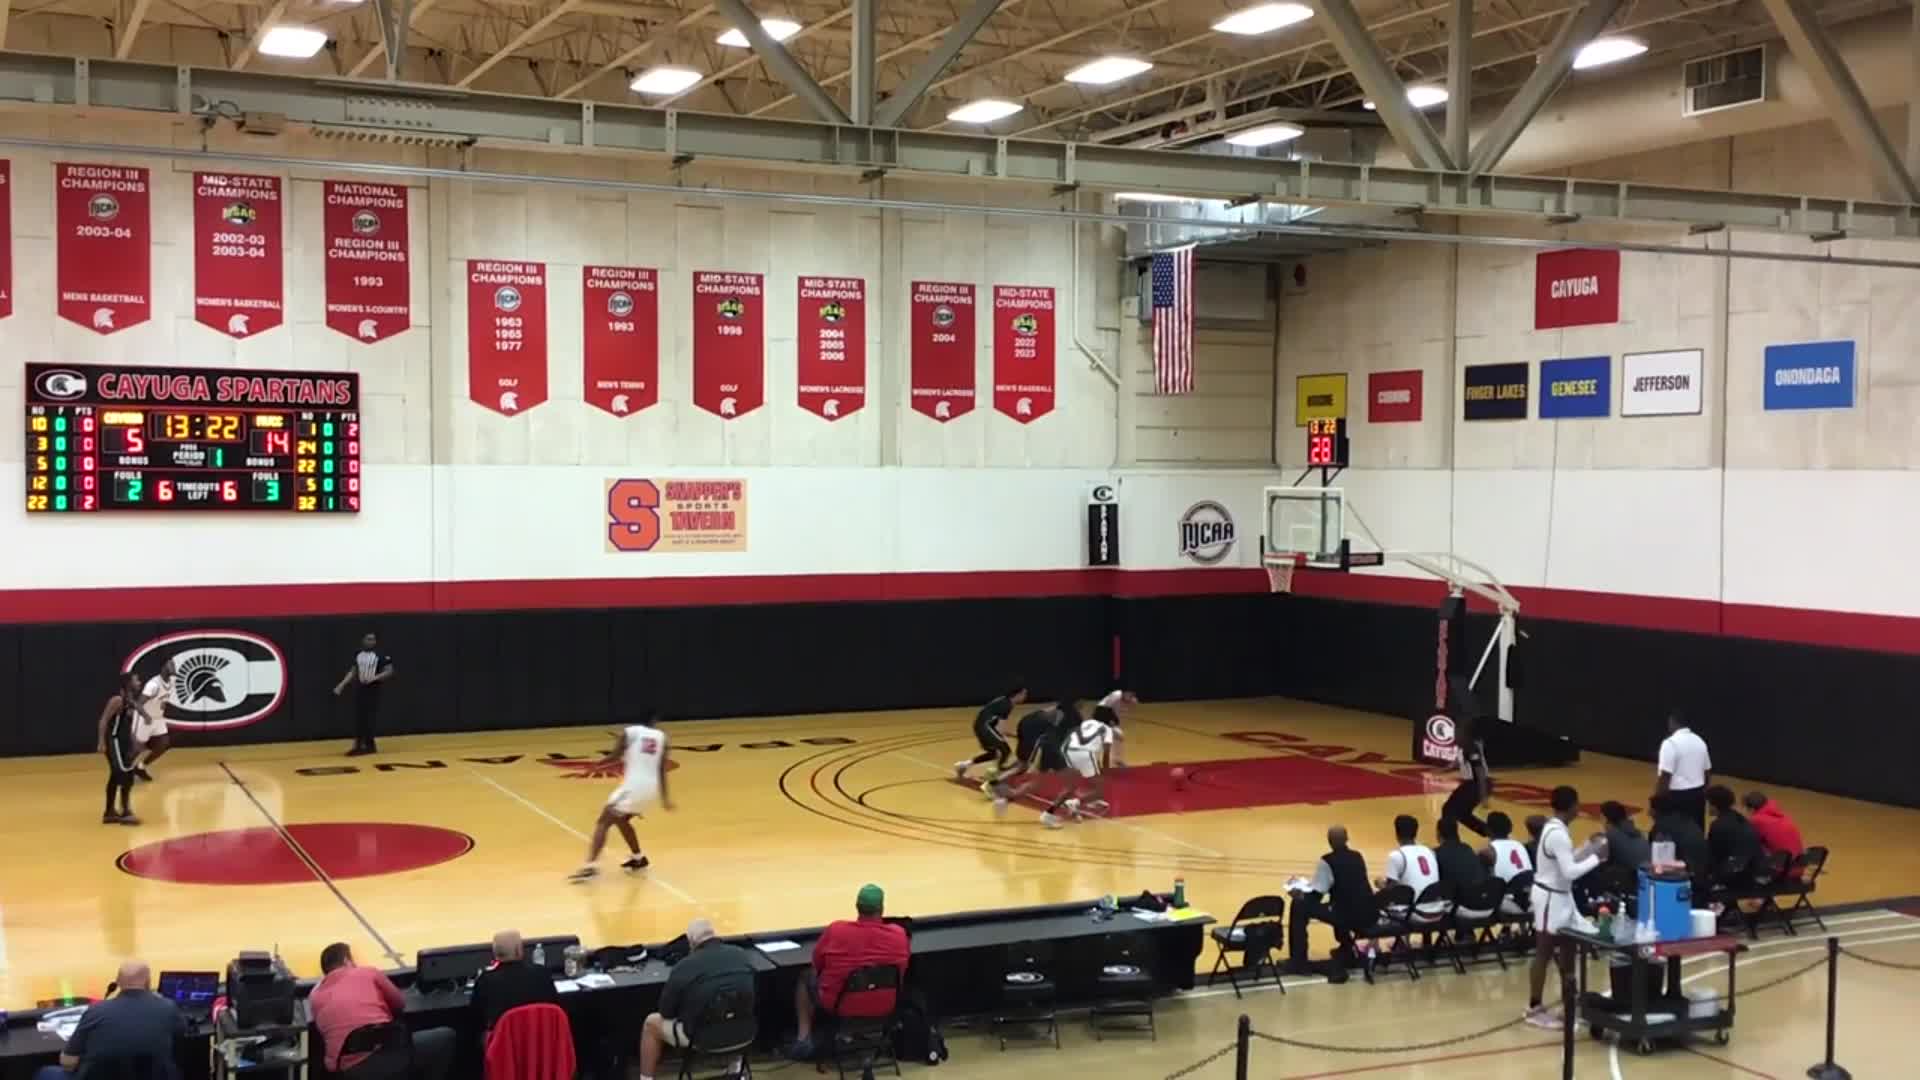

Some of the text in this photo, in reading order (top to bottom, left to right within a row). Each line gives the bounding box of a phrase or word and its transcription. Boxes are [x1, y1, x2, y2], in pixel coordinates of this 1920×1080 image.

[67, 167, 139, 180] REGION III
[61, 178, 145, 192] CHAMPIONS
[202, 175, 272, 189] MID-STATE
[198, 186, 277, 201] CHAMPIONS
[334, 184, 398, 197] NATIONAL
[328, 194, 404, 209] CHAMPIONS
[76, 225, 131, 239] 2003-04
[213, 232, 265, 245] 2002-03
[335, 237, 400, 250] REGION III
[212, 245, 265, 258] 2003-04
[329, 248, 405, 262] CHAMPIONS
[476, 262, 537, 275] REGION III
[591, 268, 649, 280] REGION III
[353, 276, 384, 287] 1993
[471, 273, 543, 286] CHAMPIONS
[587, 278, 655, 291] CHAMPIONS
[700, 274, 757, 285] MID-STATE
[804, 280, 859, 290] MID-STATE
[696, 284, 760, 296] CHAMPIONS
[919, 284, 969, 295] REGION III
[1000, 288, 1050, 299] MID-STATE
[1551, 275, 1599, 299] CAYUGA
[90, 293, 144, 304] BASKETBALL
[800, 289, 862, 300] CHAMPIONS
[914, 293, 973, 305] CHAMPIONS
[996, 298, 1053, 310] CHAMPIONS
[495, 341, 522, 351] 1977
[1774, 366, 1841, 387] ONONDAGA
[97, 373, 351, 404] CAYUGA SPARTANS
[1551, 379, 1598, 397] GENESEE
[1632, 375, 1690, 393] JEFFERSON
[1496, 384, 1526, 400] LAKES
[55, 417, 66, 432] 0
[84, 418, 94, 431] 0
[166, 415, 239, 439] 13:22
[323, 422, 334, 437] 0
[349, 423, 358, 437] 2
[38, 437, 94, 451] 3 0 0
[127, 428, 144, 453] 5
[267, 431, 289, 454] 14
[298, 441, 359, 455] 24 0 0
[1311, 437, 1331, 463] 28
[38, 456, 94, 471] 5 0 0
[119, 456, 149, 466] BONUS
[173, 452, 205, 461] PERIOD
[216, 448, 223, 468] 1
[246, 457, 275, 467] BONUS
[298, 459, 359, 474] 22 0 0
[114, 471, 142, 480] FOULS
[253, 472, 279, 481] FOULS
[33, 476, 94, 490] 12 0 0
[176, 482, 220, 492] TIMEOUTS
[306, 478, 359, 492] 5 0 0
[128, 481, 142, 501] 2
[158, 481, 173, 501] 6
[188, 491, 208, 501] LEFT
[223, 481, 237, 501] 6
[266, 481, 280, 501] 3
[28, 495, 94, 510] 22 0 2
[298, 496, 316, 510] 32
[328, 497, 334, 510] 1
[677, 502, 729, 510] SPORTS
[608, 478, 660, 551] S
[669, 511, 736, 530] TAVERN
[1180, 521, 1235, 552] NJCAA
[1416, 855, 1431, 877] 0
[1509, 849, 1524, 870] 4
